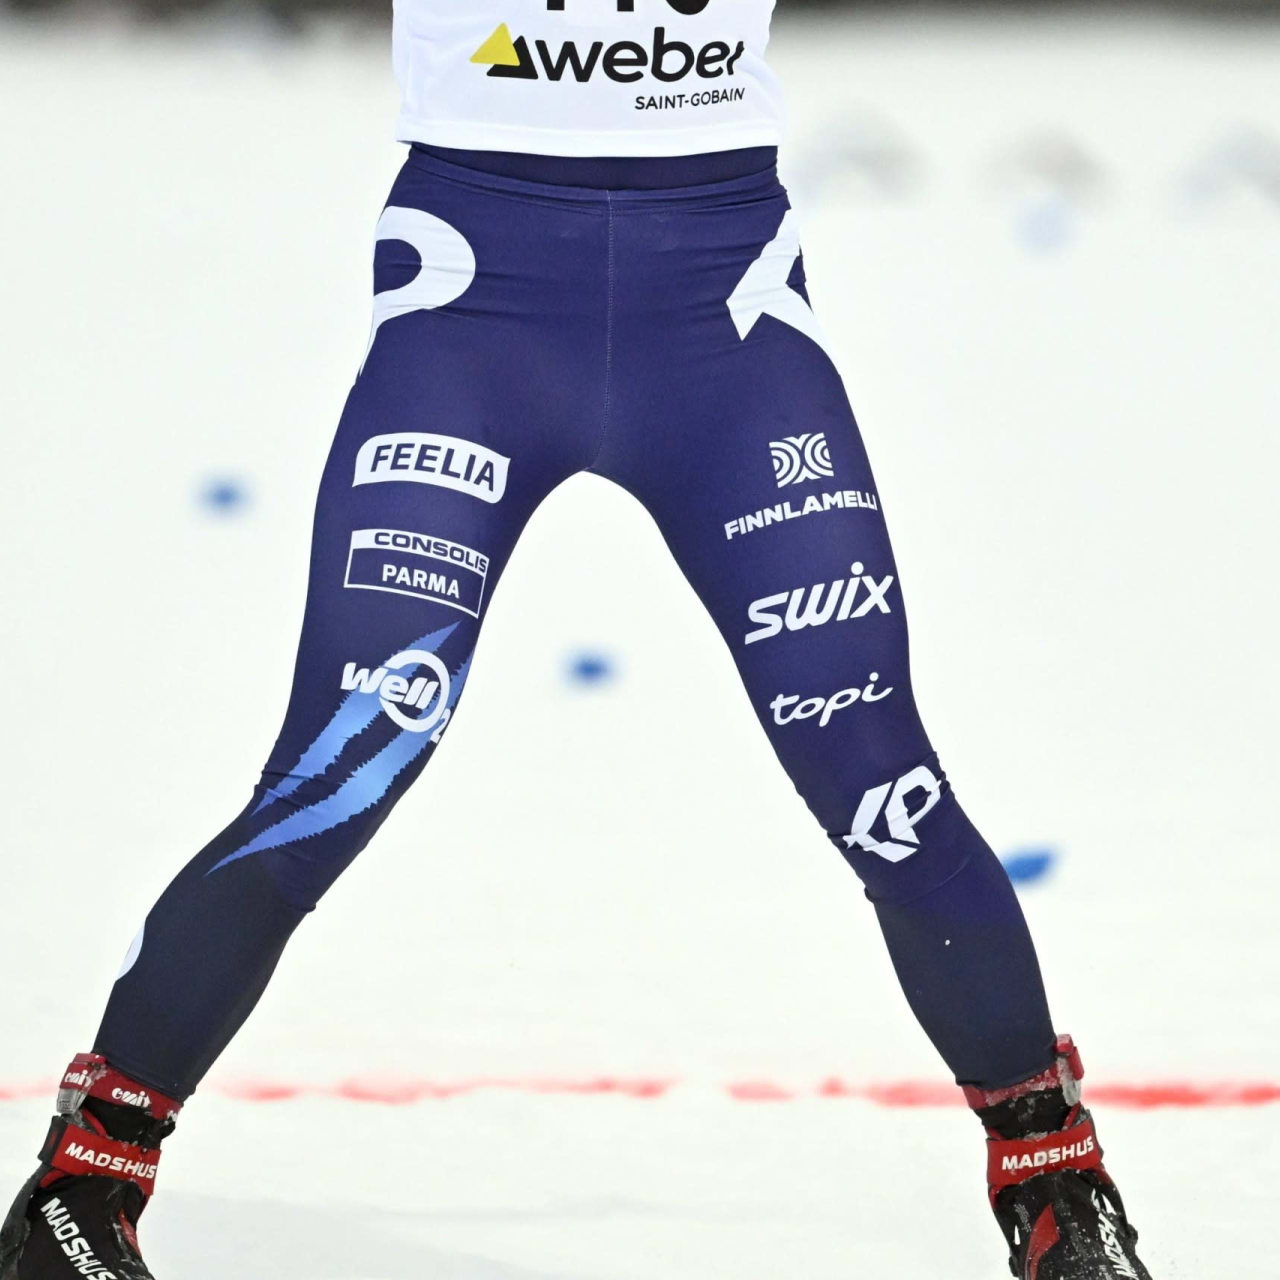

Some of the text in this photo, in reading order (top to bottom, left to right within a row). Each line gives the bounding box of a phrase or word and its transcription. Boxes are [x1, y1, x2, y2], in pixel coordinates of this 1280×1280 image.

[535, 27, 745, 83] weber
[635, 87, 745, 110] SAINT-GOBAIN
[370, 443, 495, 492] FEELIA
[374, 532, 488, 573] CONSOLIS
[382, 564, 460, 599] PARMA
[769, 672, 893, 727] topi
[65, 1142, 158, 1179] MADSHUS
[1001, 1136, 1095, 1170] MADSHUS
[40, 1197, 119, 1280] MADSHUS
